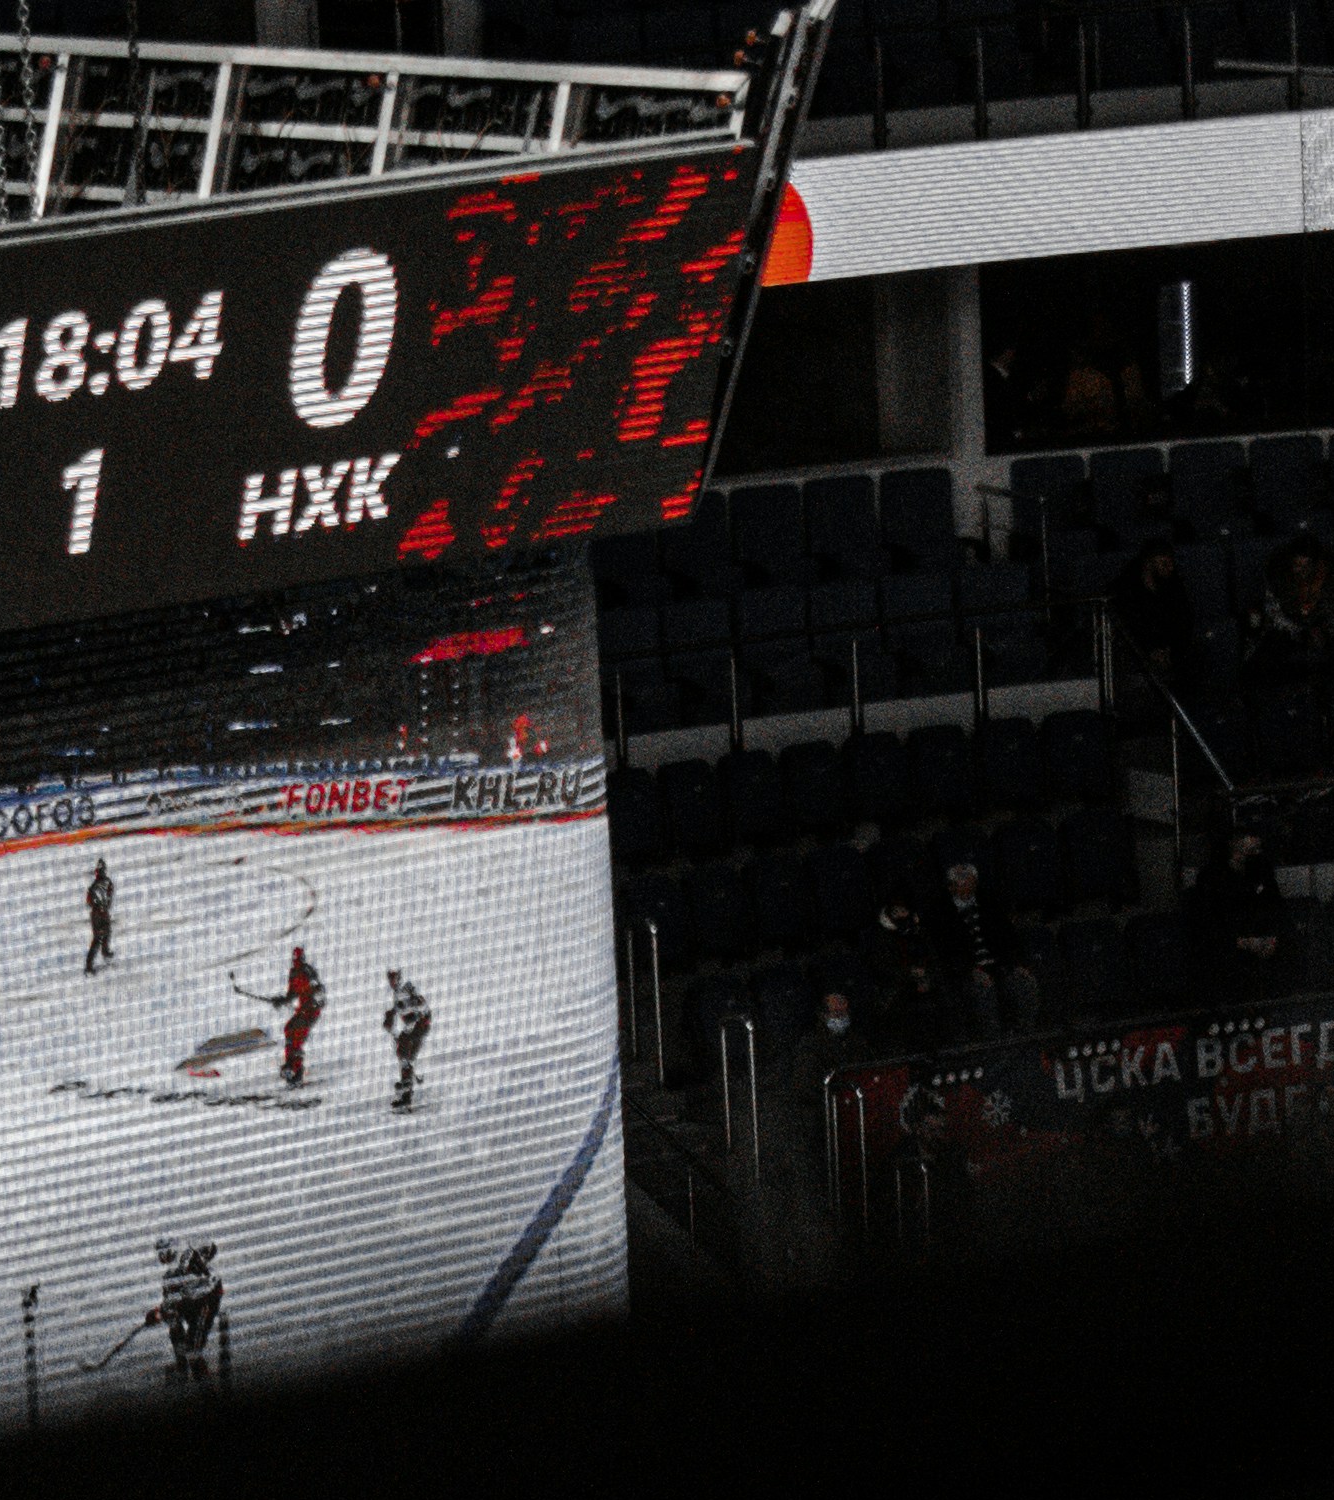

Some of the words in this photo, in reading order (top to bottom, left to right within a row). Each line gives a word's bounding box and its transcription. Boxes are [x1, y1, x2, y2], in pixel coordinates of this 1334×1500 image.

[290, 248, 397, 427] 0
[63, 448, 104, 554] 1
[237, 453, 401, 541] НХК
[1053, 1043, 1181, 1102] ЦСКА
